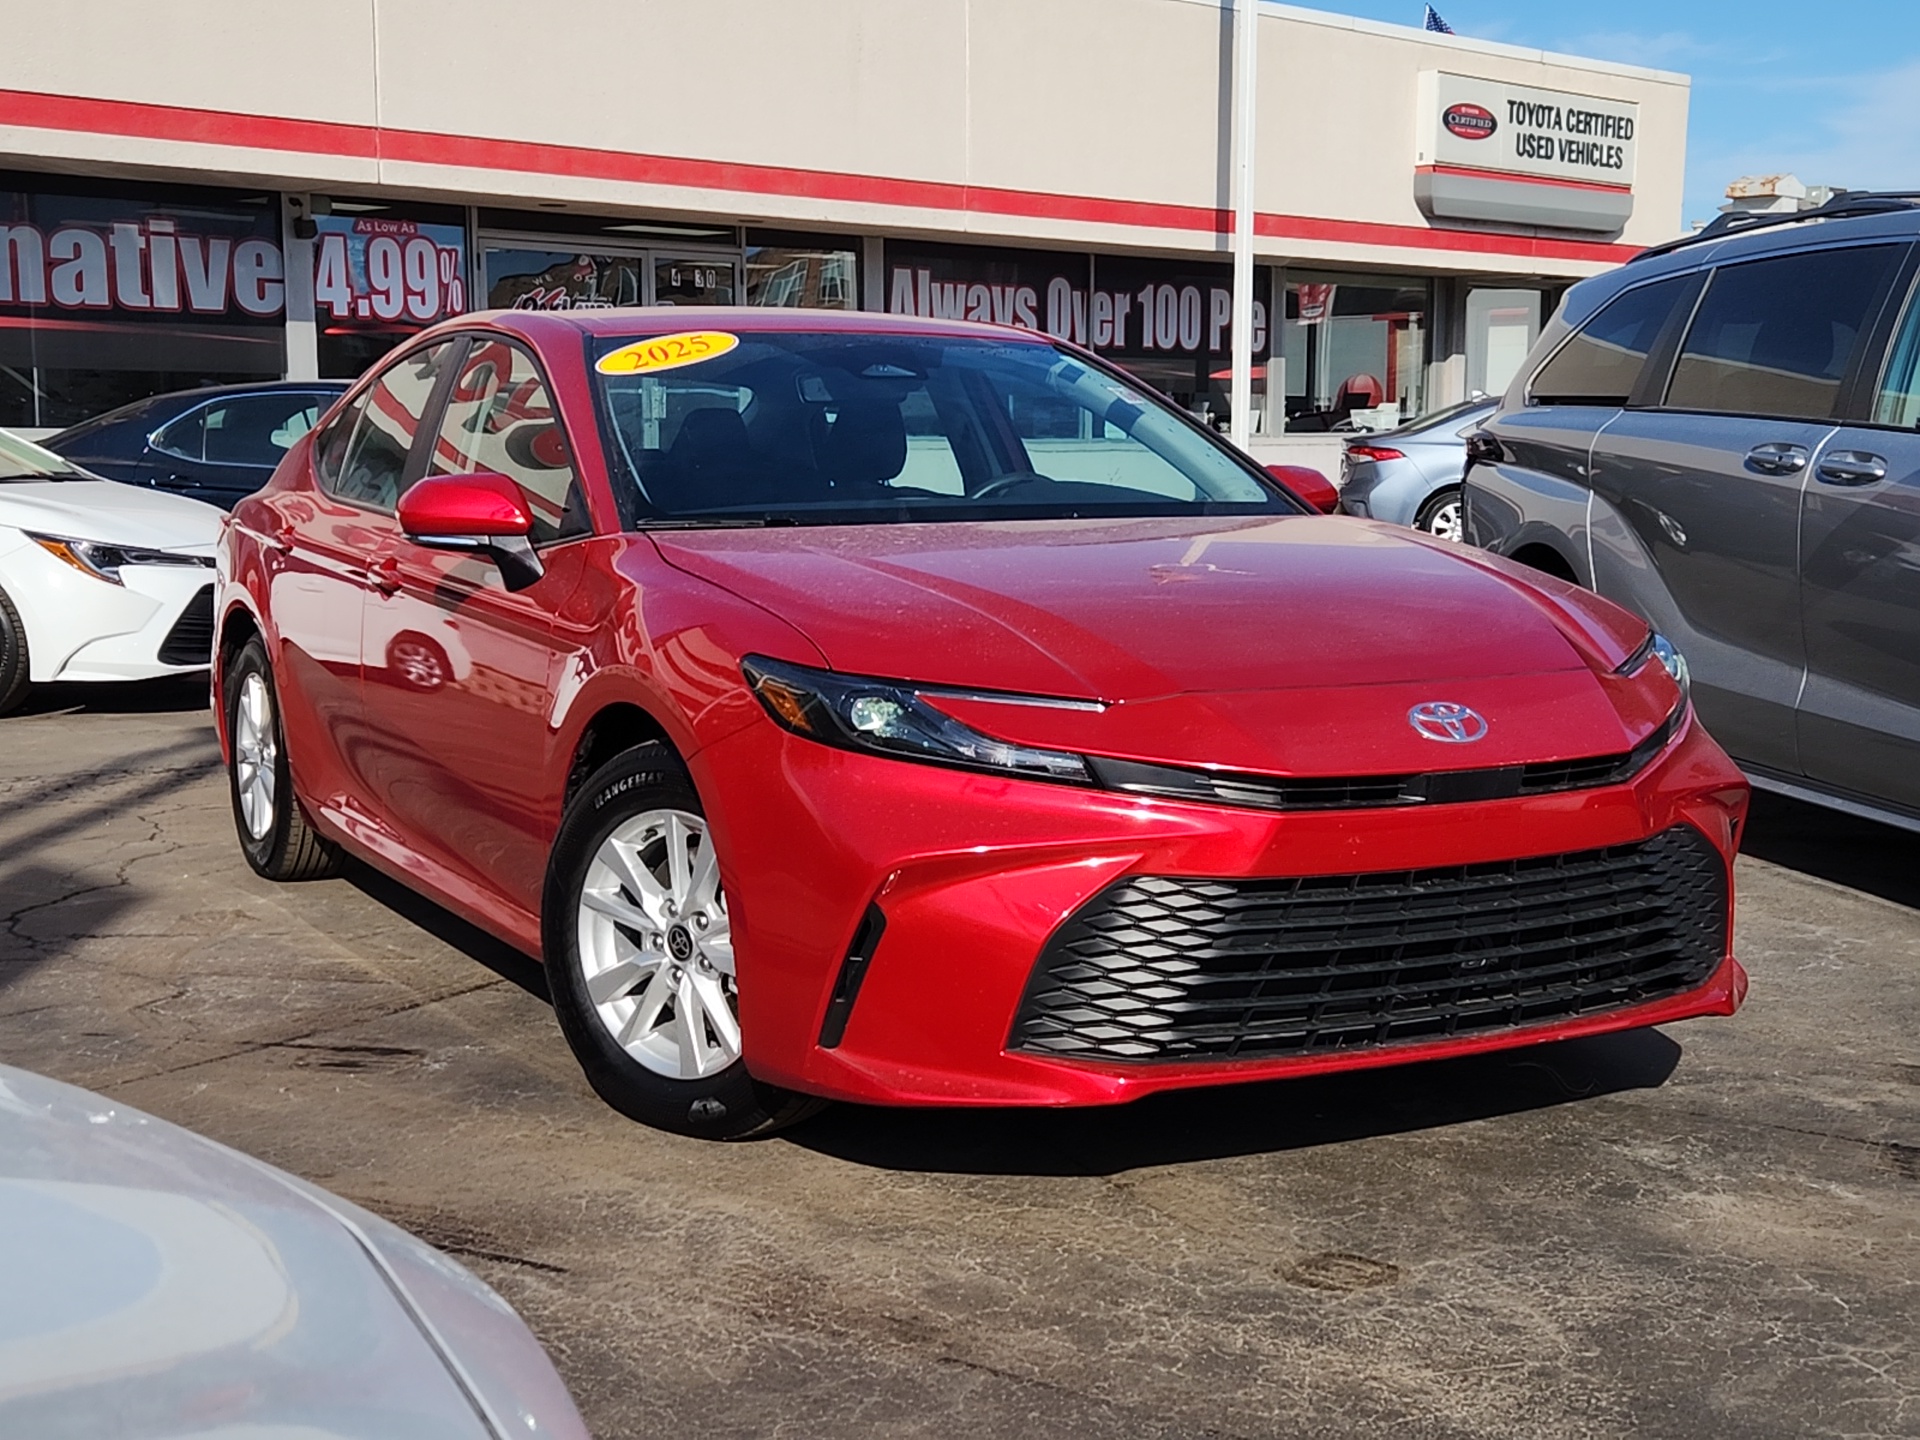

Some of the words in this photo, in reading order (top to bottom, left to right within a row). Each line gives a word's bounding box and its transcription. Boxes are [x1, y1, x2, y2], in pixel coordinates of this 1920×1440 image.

[1507, 99, 1562, 131] TOYOTA
[1566, 108, 1634, 141] CERTIFIED
[1516, 132, 1555, 160] USED
[1558, 138, 1623, 170] VEHICLES
[356, 220, 371, 231] As
[374, 221, 397, 232] Low
[401, 223, 415, 234] As
[0, 219, 285, 314] native
[316, 235, 463, 320] 4.99%
[890, 267, 1038, 331] Always
[1047, 276, 1131, 347] Over
[1137, 283, 1201, 350] 100
[1209, 287, 1267, 353] Pe
[624, 335, 710, 370] 2025
